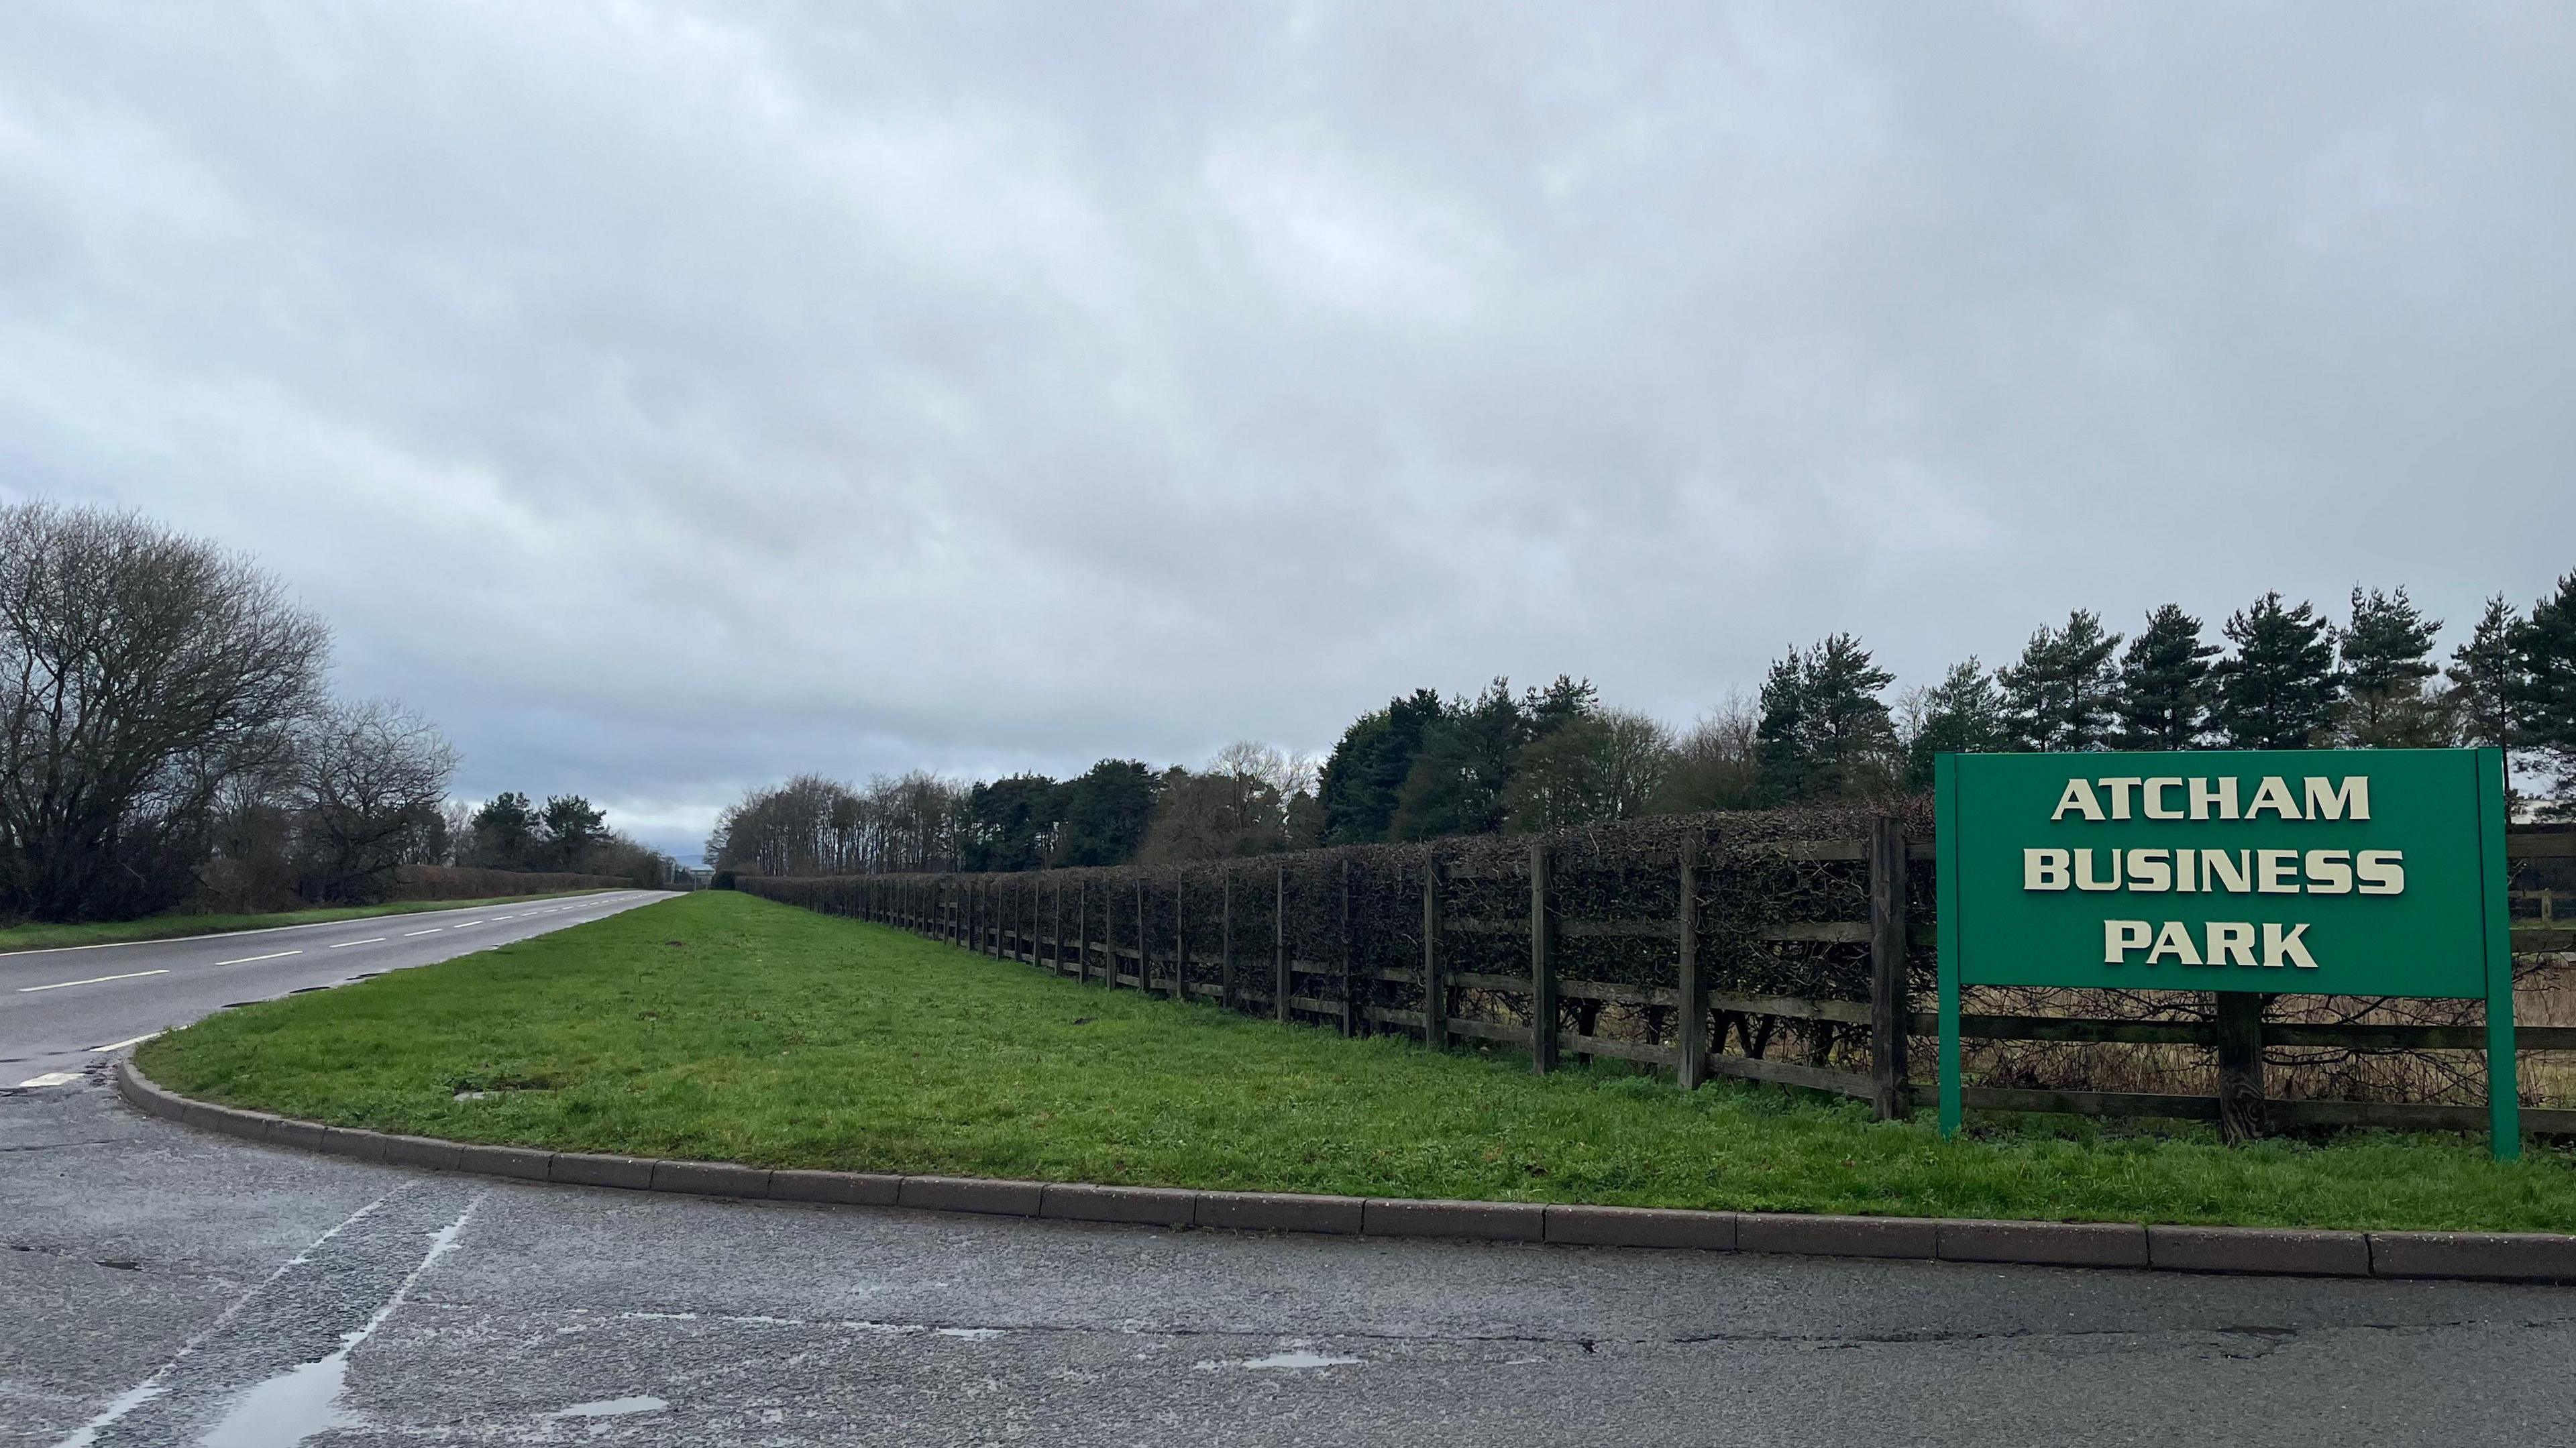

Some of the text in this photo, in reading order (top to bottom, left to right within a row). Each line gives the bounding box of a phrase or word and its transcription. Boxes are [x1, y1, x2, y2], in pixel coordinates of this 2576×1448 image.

[2051, 776, 2371, 820] ATCHAM
[2023, 848, 2404, 895] BUSINESS
[2104, 920, 2318, 968] PARK
